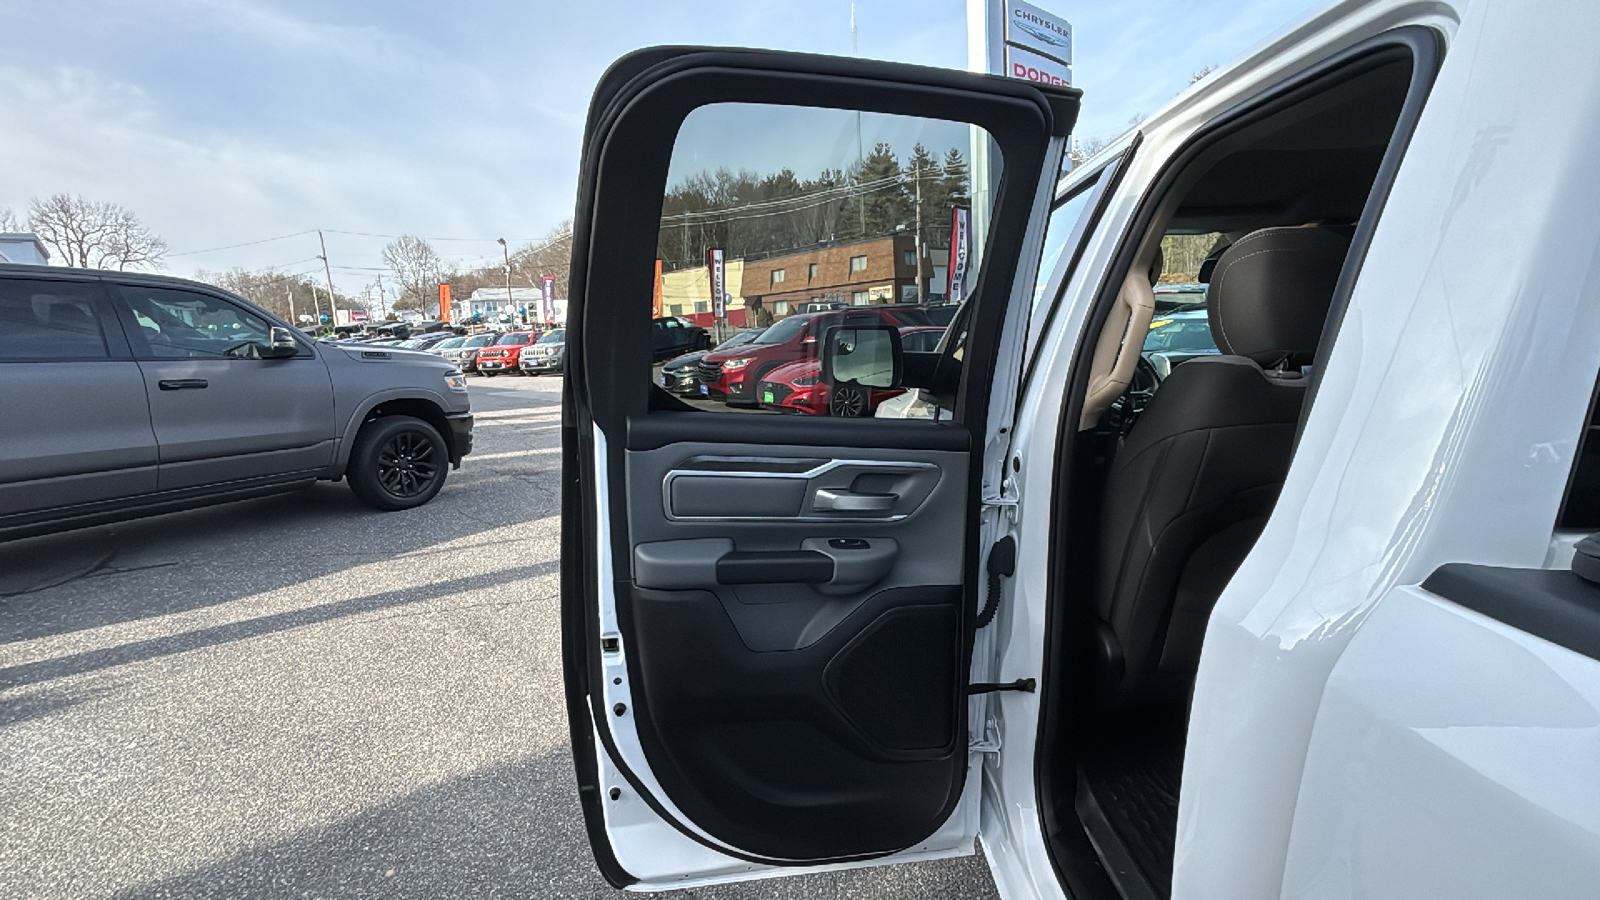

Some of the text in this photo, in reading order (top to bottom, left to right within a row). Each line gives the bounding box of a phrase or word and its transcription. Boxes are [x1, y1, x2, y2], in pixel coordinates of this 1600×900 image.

[1014, 9, 1069, 38] CHRYSLER
[952, 221, 965, 290] WELCOME
[714, 259, 722, 309] WELCOME
